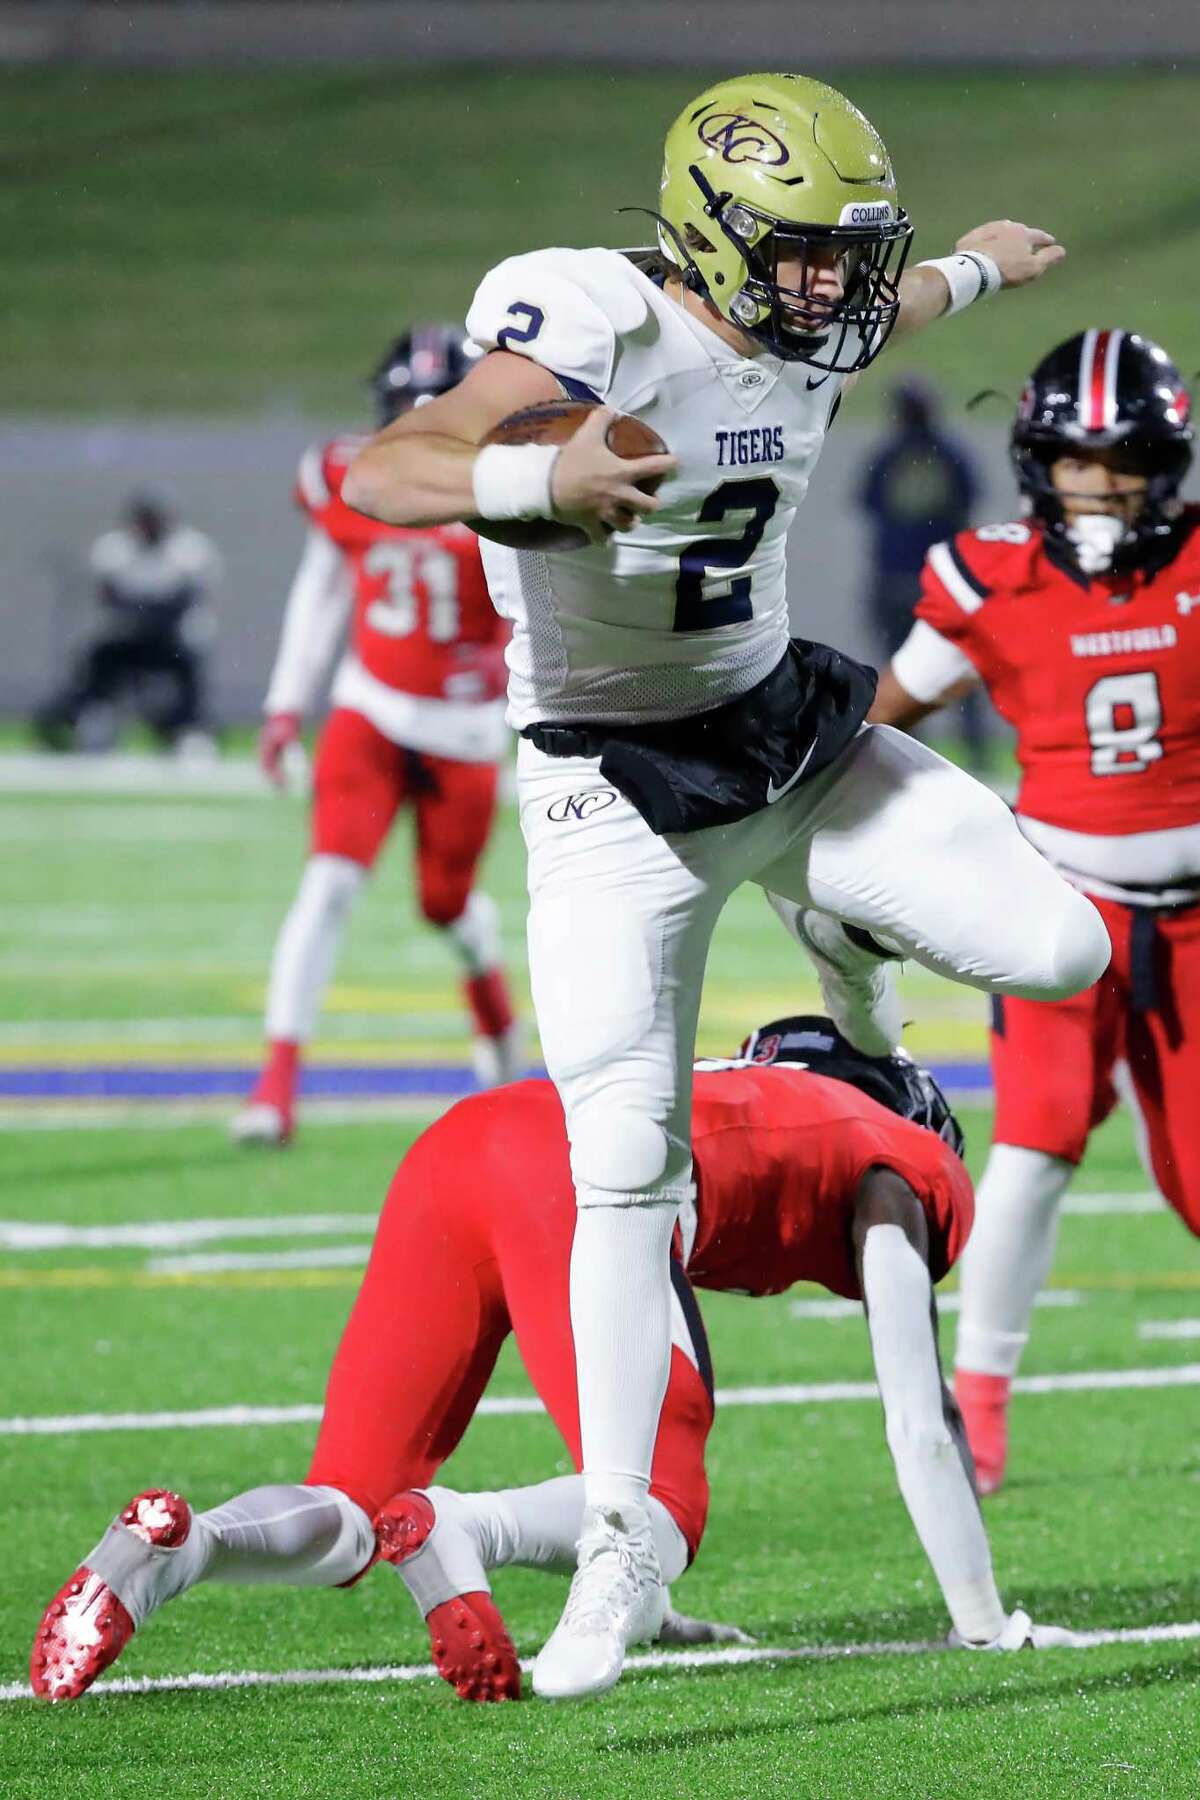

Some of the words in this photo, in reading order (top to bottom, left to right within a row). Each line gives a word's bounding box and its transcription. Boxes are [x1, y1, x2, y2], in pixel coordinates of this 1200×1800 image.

[851, 205, 890, 223] COLLINS
[497, 301, 545, 348] 2
[715, 425, 785, 466] TIGERS
[364, 538, 458, 644] 31
[672, 476, 782, 632] 2
[1085, 669, 1162, 775] 8
